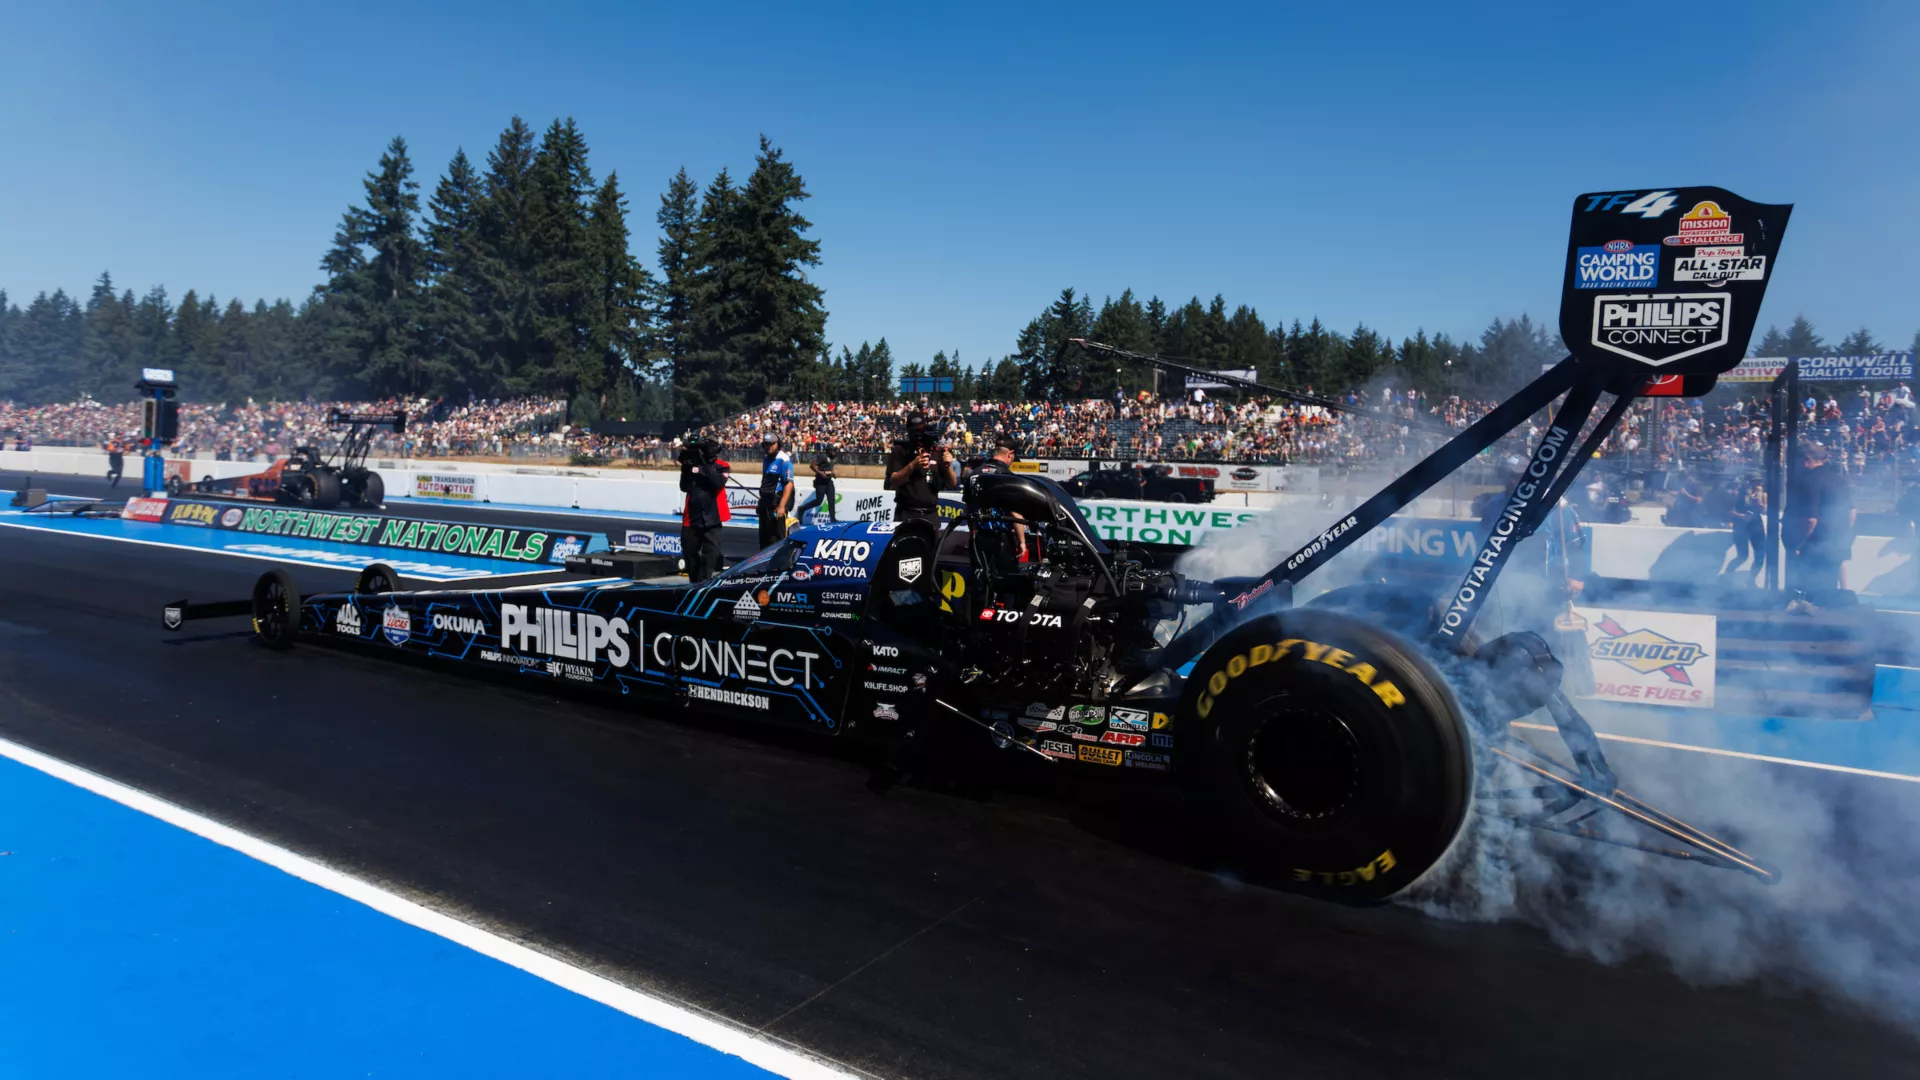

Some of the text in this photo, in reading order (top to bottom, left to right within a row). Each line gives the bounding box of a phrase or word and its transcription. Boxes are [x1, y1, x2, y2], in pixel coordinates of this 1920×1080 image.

[1607, 241, 1631, 251] NHRA
[1683, 235, 1740, 244] CHALLENGE
[1580, 252, 1655, 266] CAMPING
[1677, 258, 1763, 271] ALL STAR
[1580, 265, 1654, 281] WORLD
[1692, 271, 1742, 279] CALLOUT
[1603, 302, 1721, 327] PHILLIPS
[1608, 329, 1712, 344] CONNECT
[1798, 354, 1912, 369] CORNWELL
[1862, 366, 1913, 376] TOOLS
[417, 482, 475, 493] AUTOMOTIVE
[856, 496, 883, 511] HOME
[874, 509, 891, 522] THE
[238, 508, 381, 543] NORTHWEST
[378, 519, 548, 560] NATIONALS
[1439, 426, 1568, 636] TOYOTARACING.COM
[654, 535, 681, 544] CAMPING
[1287, 515, 1359, 571] GOODYEAR
[654, 543, 681, 553] WORLD
[814, 539, 870, 562] KATO
[823, 565, 867, 578] TOYOTA
[821, 592, 854, 600] CENTURY
[336, 603, 361, 626] MAC
[996, 609, 1062, 627] TOOTA
[336, 624, 361, 635] TOOLS
[387, 618, 409, 629] LUCAS
[433, 614, 486, 635] OKUMA
[501, 603, 819, 689] PHILLIPS CONNECT
[873, 645, 899, 657] KATO
[1598, 640, 1696, 662] SUNOCO
[480, 650, 502, 662] PHILLIPS
[564, 663, 594, 677] WYAKIN
[877, 665, 908, 674] IMPACT
[565, 673, 594, 682] FOUNDATION
[1196, 638, 1406, 719] GOODYEAR
[864, 682, 908, 693] K9LIFE.SHOP
[1595, 682, 1703, 701] RACE FUELS
[697, 686, 770, 710] HENDRICKSON
[1101, 731, 1146, 746] ARP
[1041, 740, 1076, 755] JESEL
[1081, 746, 1121, 760] BULLET
[1292, 849, 1397, 887] EAGLE
